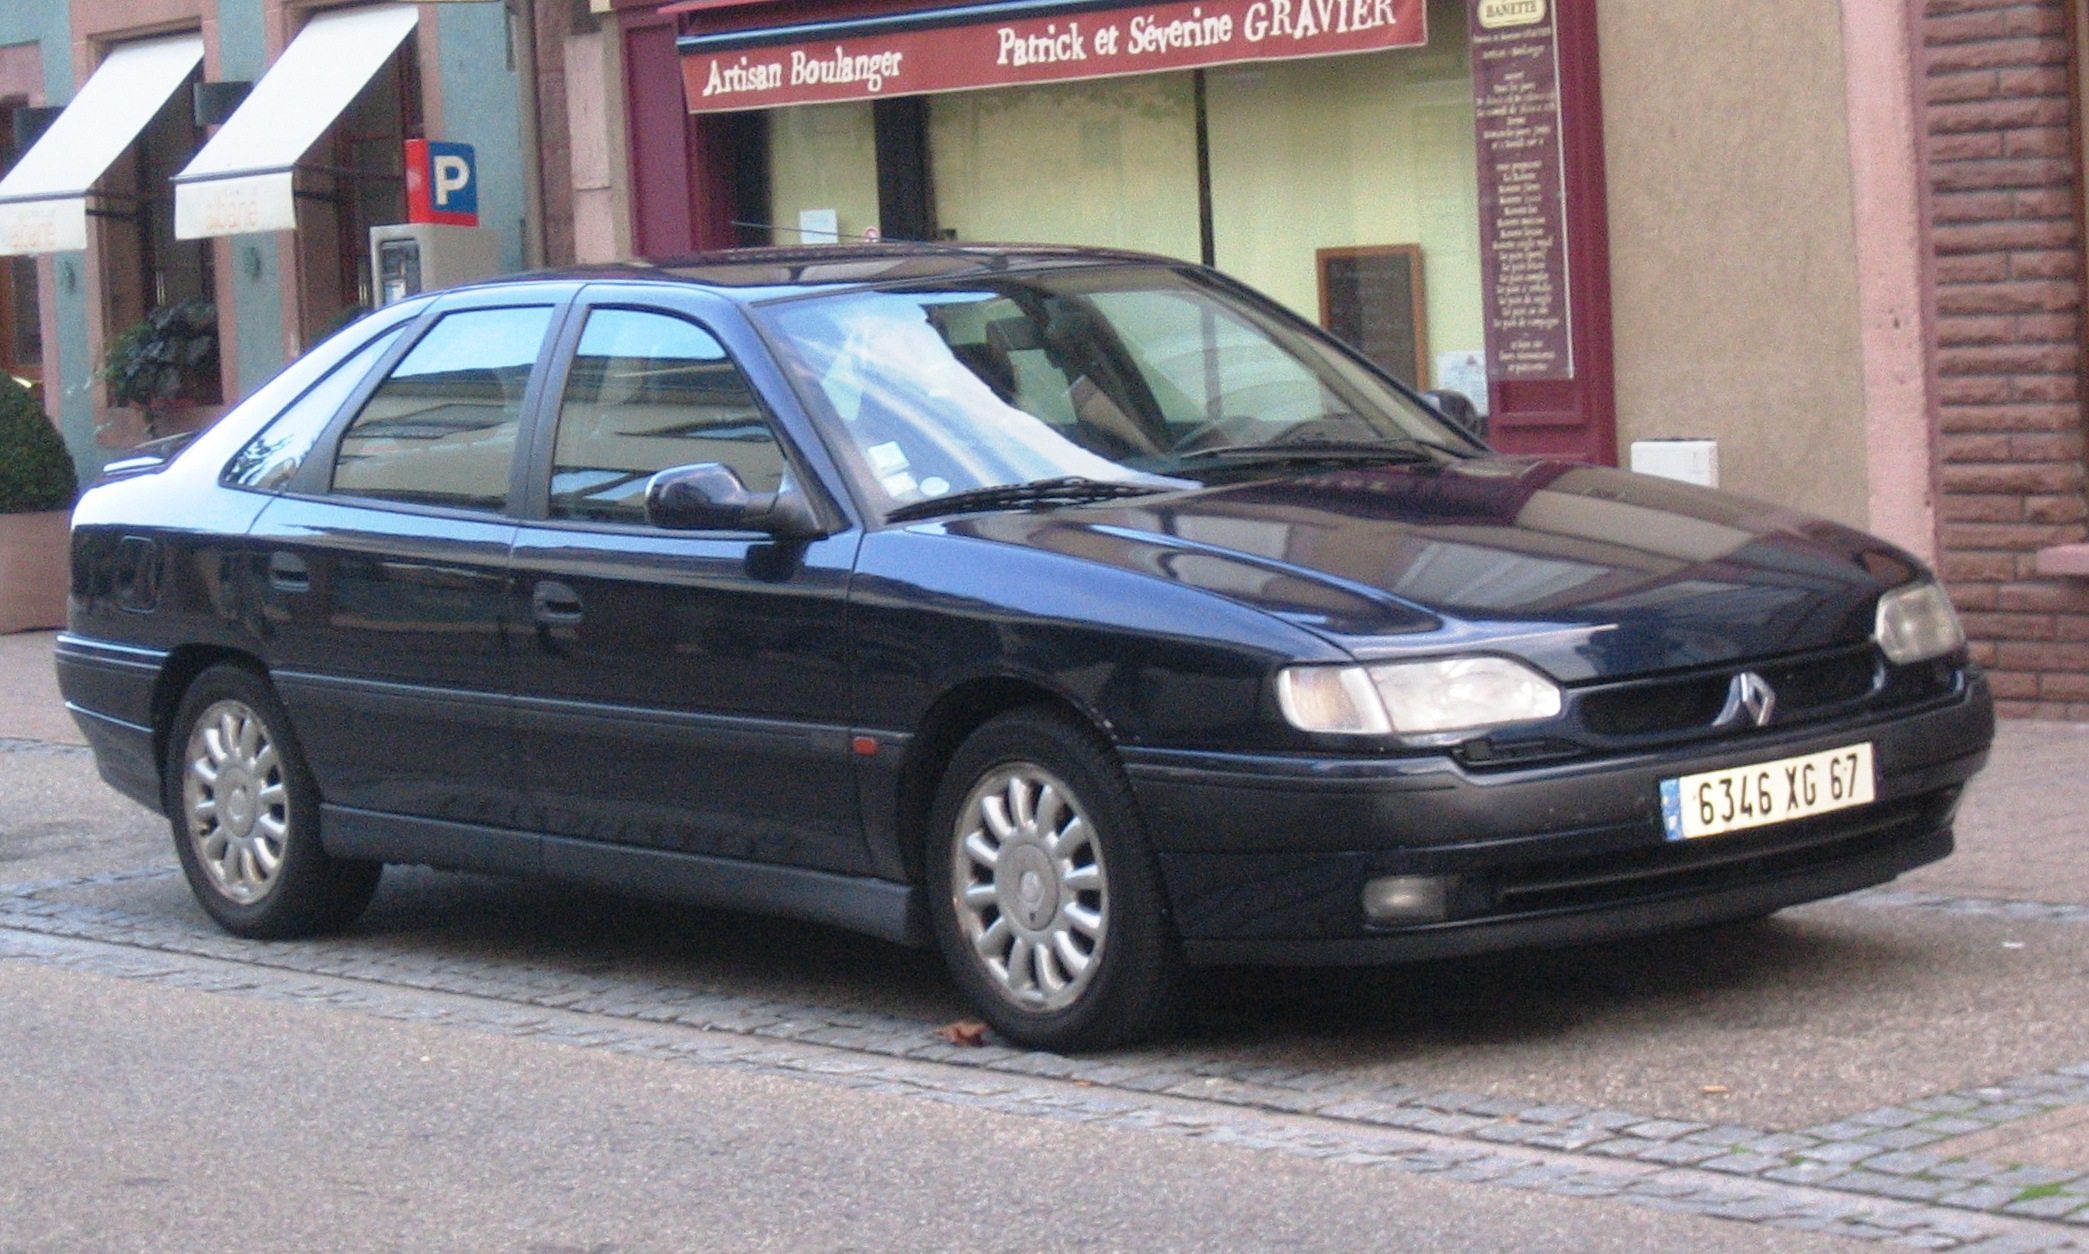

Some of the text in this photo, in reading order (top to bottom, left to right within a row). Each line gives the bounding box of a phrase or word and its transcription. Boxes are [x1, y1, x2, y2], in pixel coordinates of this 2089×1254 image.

[996, 0, 1396, 66] Patrick et Séverine GRAVIER
[702, 45, 903, 97] Artisan Boulanger
[433, 155, 471, 206] P
[1698, 752, 1858, 826] 6346 XG 67
